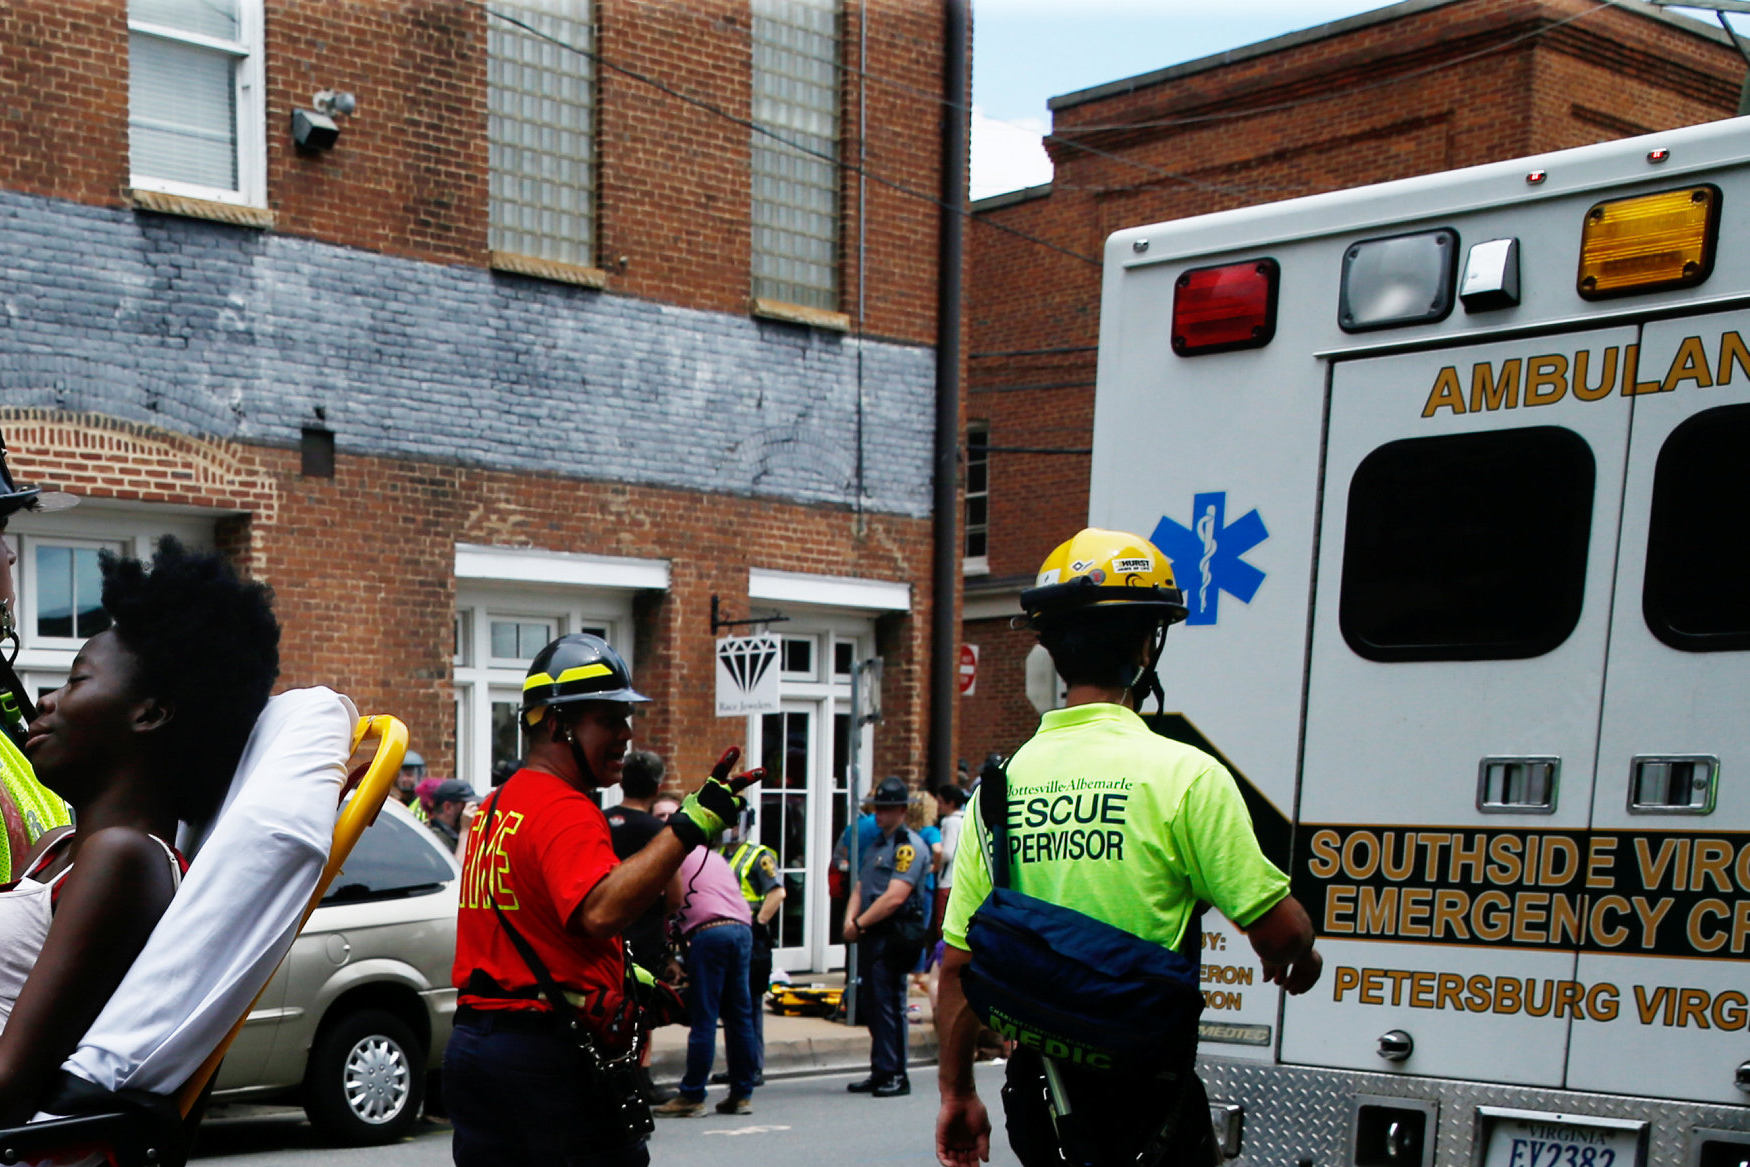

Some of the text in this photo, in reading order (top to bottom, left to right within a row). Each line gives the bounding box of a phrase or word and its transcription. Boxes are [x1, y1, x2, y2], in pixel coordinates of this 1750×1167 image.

[1421, 331, 1750, 418] AMBULAN
[1007, 793, 1129, 829] ESCUE
[988, 829, 1124, 864] PERVISOR
[1307, 829, 1618, 889] SOUTHSIDE
[1323, 885, 1675, 949] EMERGENCY
[1200, 964, 1253, 985] ERON
[1333, 966, 1750, 1031] PETERSBURG VIRG
[989, 1014, 1113, 1069] MEDIC
[1529, 1123, 1607, 1146] VIRGINIA
